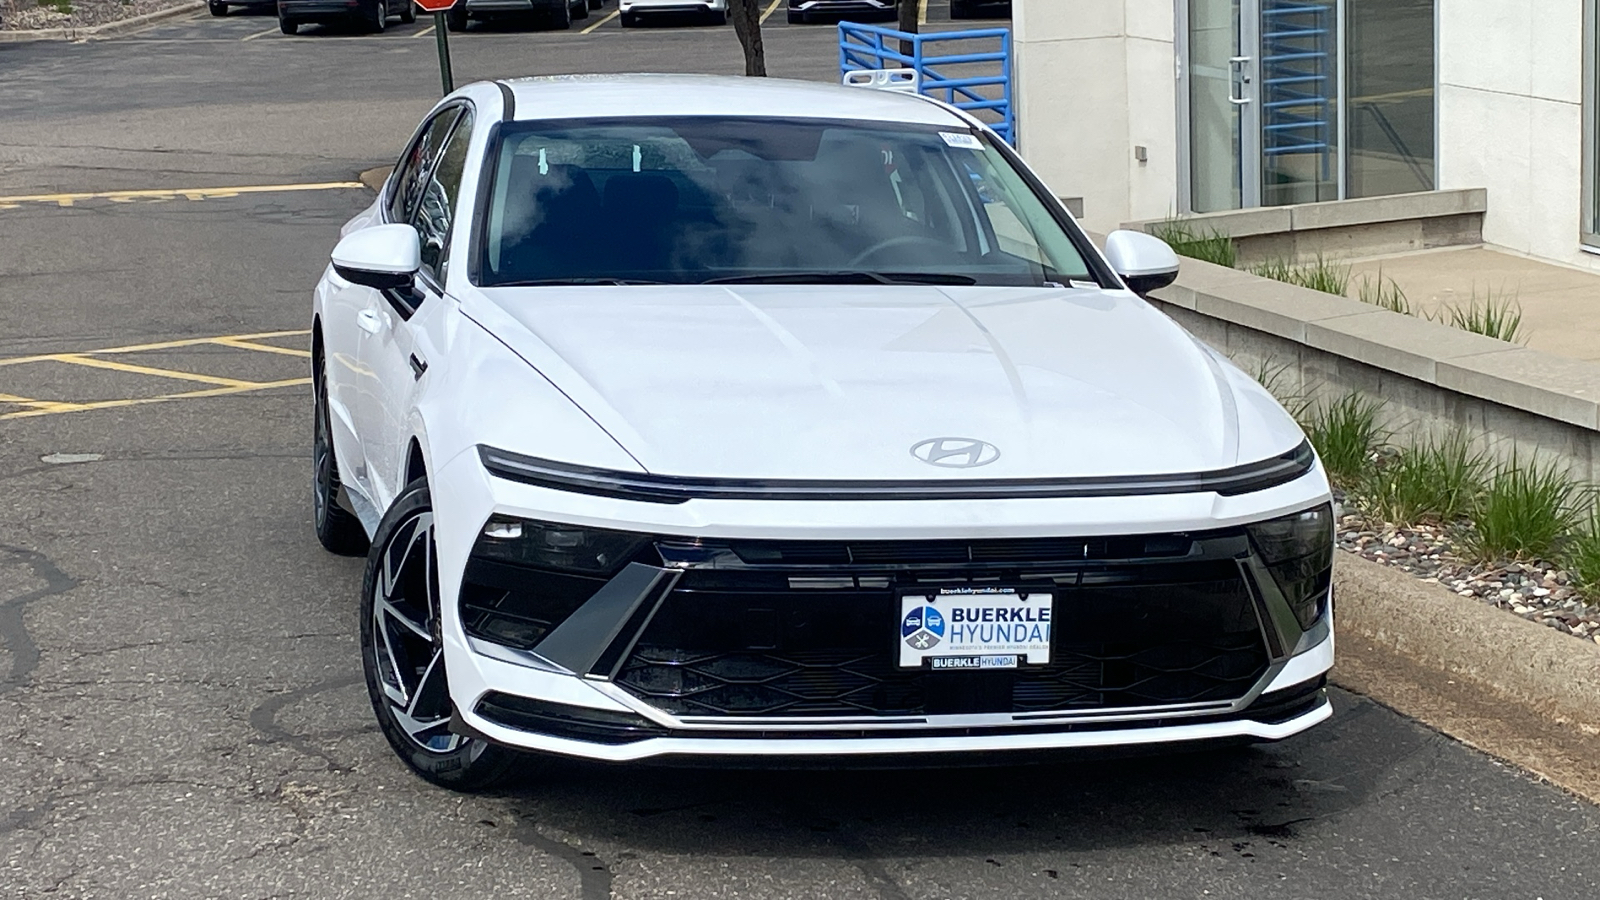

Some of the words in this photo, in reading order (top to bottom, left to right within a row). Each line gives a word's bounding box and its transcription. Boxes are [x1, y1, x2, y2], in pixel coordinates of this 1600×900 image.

[952, 608, 1050, 622] BUERKLE
[950, 624, 1050, 643] HYUNDAI
[934, 658, 980, 668] BUERKLE
[982, 657, 1015, 666] HYUNDAI
